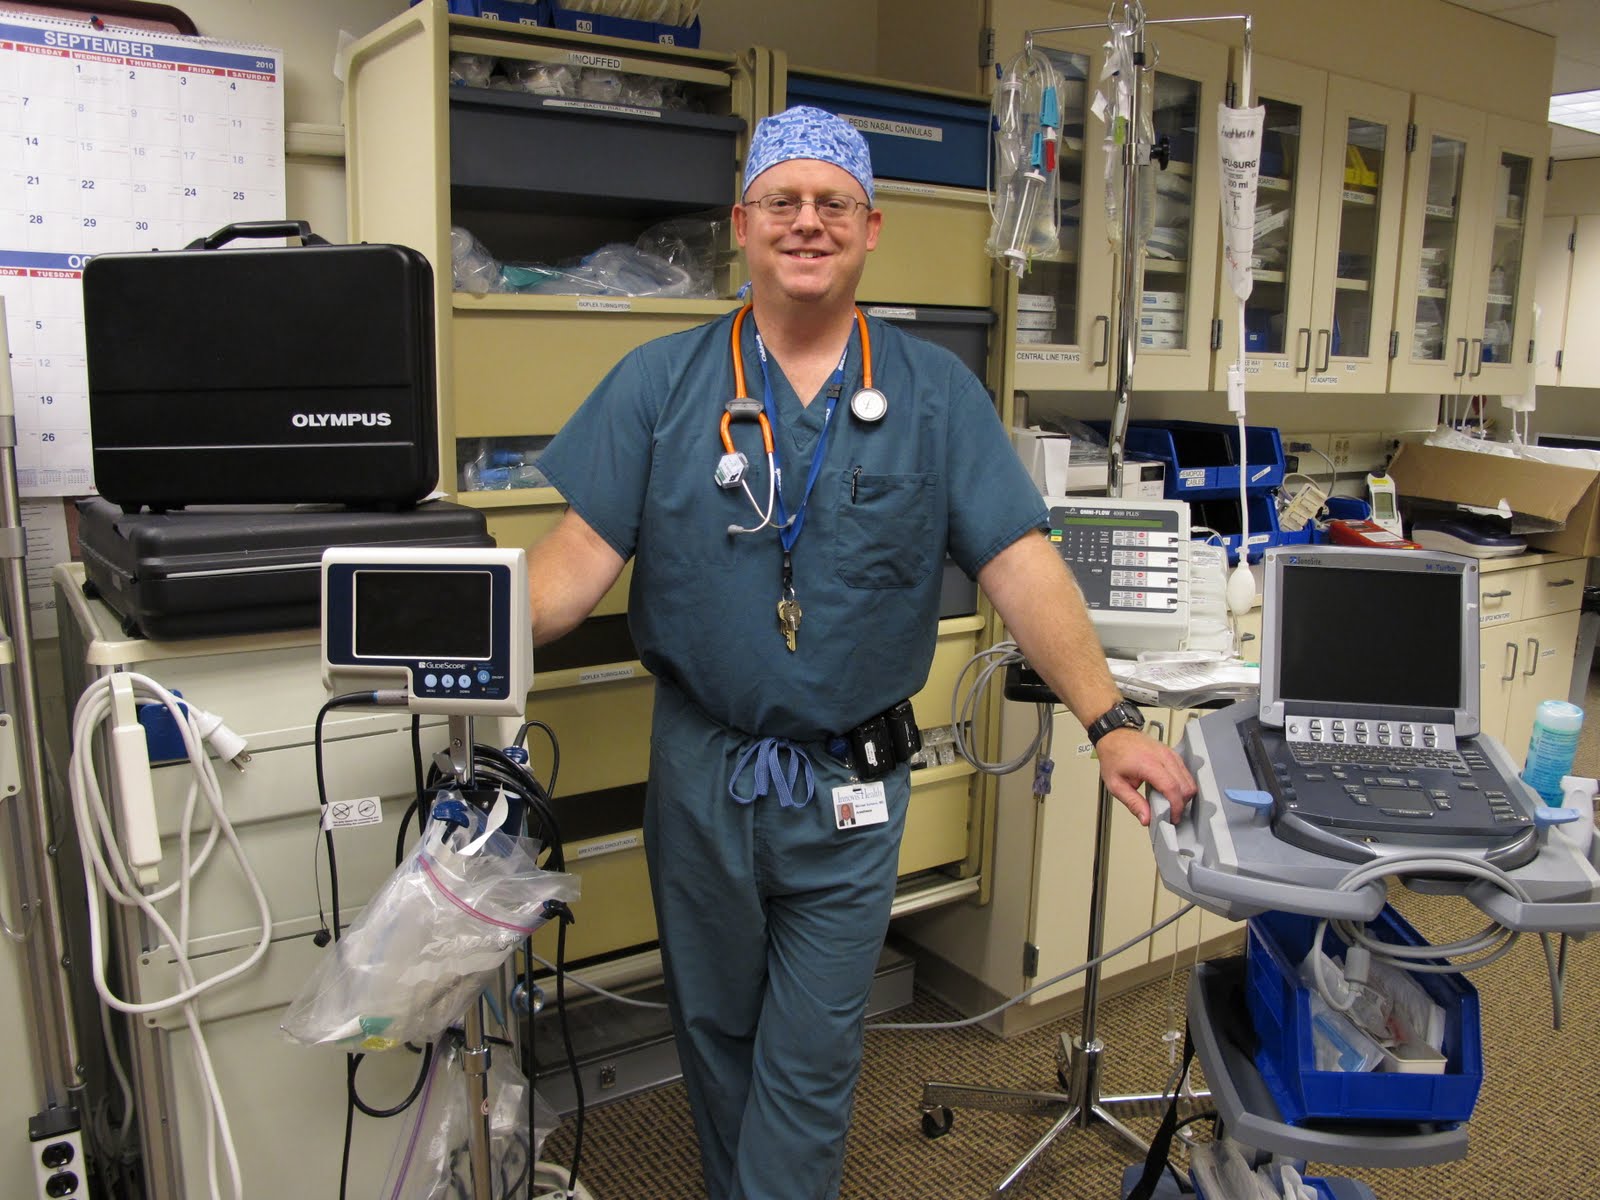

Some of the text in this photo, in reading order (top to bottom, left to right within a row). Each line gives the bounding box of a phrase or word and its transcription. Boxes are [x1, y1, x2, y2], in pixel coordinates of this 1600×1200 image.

[578, 20, 592, 31] 4.0
[44, 31, 154, 58] SEPTEMBER
[660, 36, 674, 45] 4.5
[23, 46, 272, 80] TUESDAY WEDNESDAY THURSDAY FRIDAY SATURDAY
[255, 60, 274, 70] 2010
[568, 54, 621, 68] UNCUFFED
[76, 64, 81, 73] 1
[129, 70, 136, 80] 2
[180, 76, 187, 86] 3
[230, 82, 236, 90] 4
[22, 97, 29, 106] 7
[78, 103, 84, 112] 8
[130, 109, 138, 118] 9
[182, 114, 194, 124] 10
[231, 119, 242, 128] 11
[848, 118, 933, 138] PEDS NASAL CANNULAS
[25, 137, 39, 146] 14
[80, 142, 93, 152] 15
[132, 147, 145, 156] 16
[184, 152, 195, 160] 17
[232, 155, 244, 164] 18
[26, 176, 40, 185] 21
[82, 180, 95, 190] 22
[134, 184, 146, 193] 23
[184, 188, 197, 197] 24
[232, 191, 245, 200] 25
[29, 214, 43, 224] 28
[83, 218, 96, 228] 29
[135, 221, 148, 231] 30
[35, 320, 42, 330] 5
[38, 358, 50, 368] 12
[40, 396, 53, 405] 19
[292, 413, 392, 427] OLYMPUS
[42, 433, 55, 442] 26
[1298, 556, 1321, 565] SonoSite
